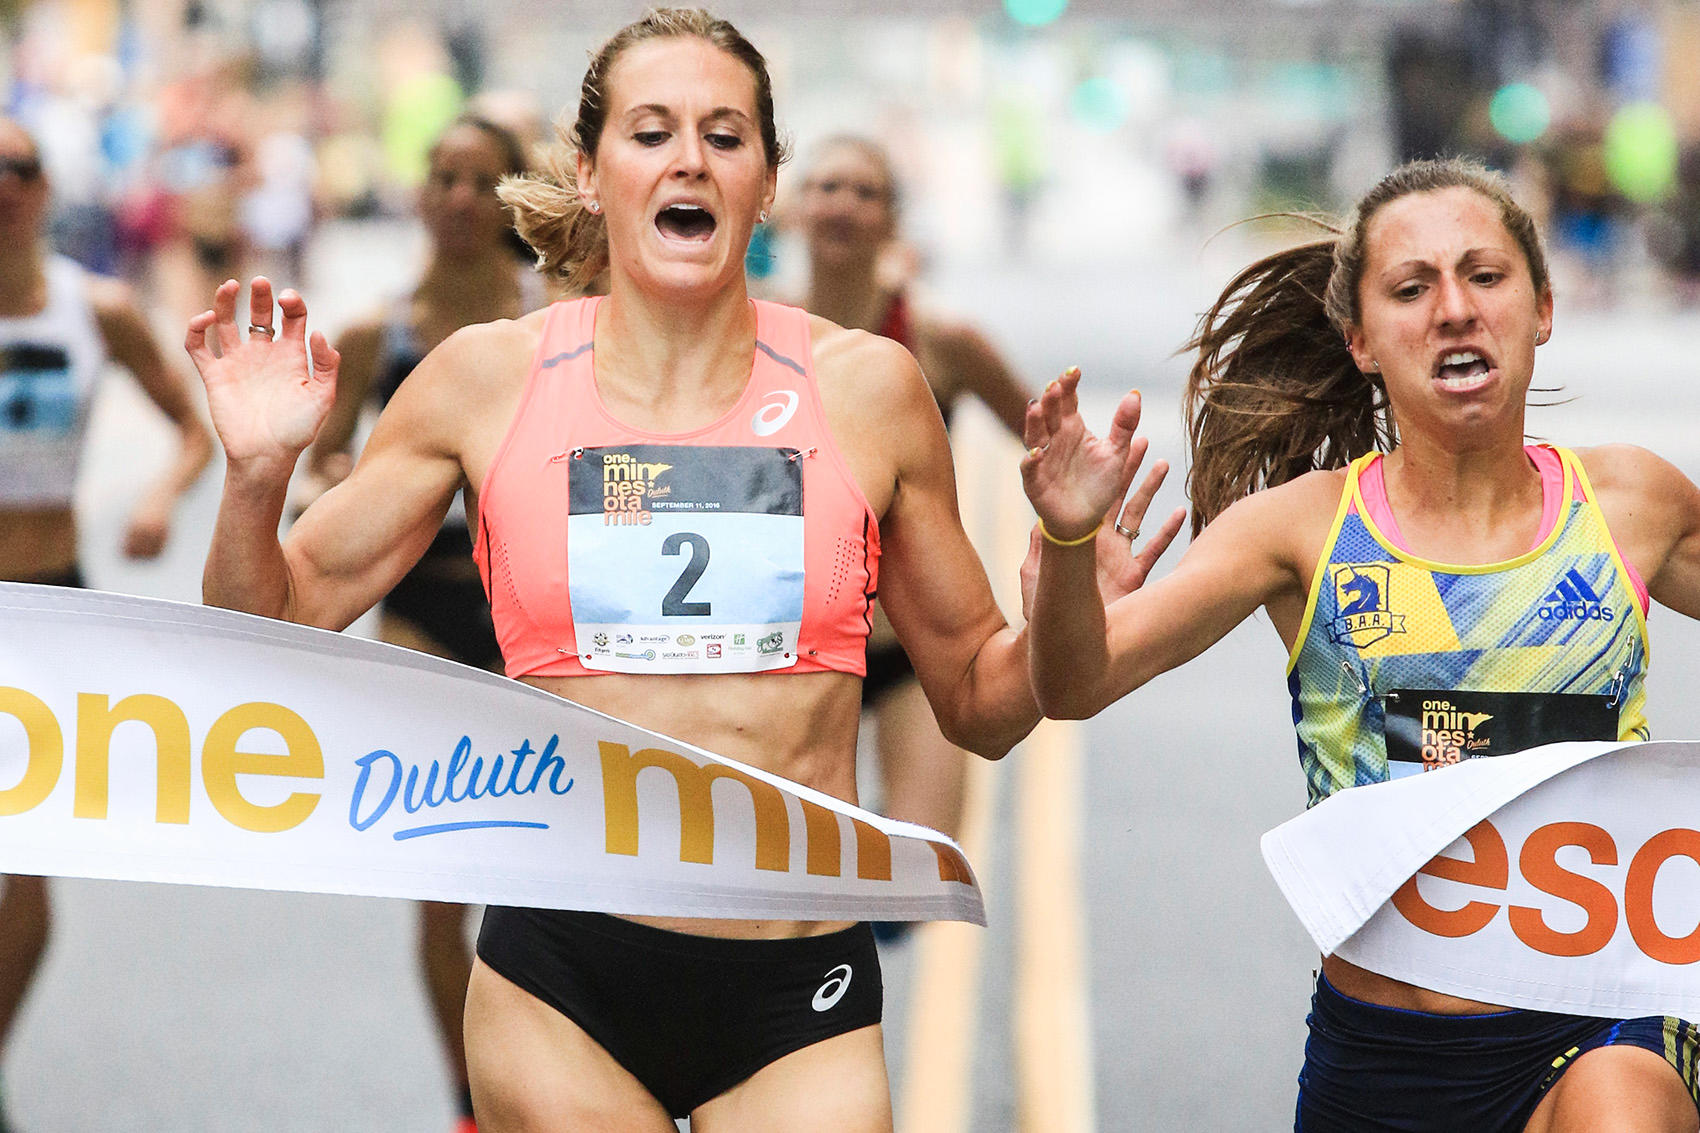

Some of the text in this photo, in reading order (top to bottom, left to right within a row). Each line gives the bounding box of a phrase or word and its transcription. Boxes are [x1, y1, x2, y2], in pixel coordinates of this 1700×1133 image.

[603, 453, 630, 464] one
[603, 457, 672, 481] min
[603, 480, 646, 497] nes
[603, 494, 642, 511] ota
[695, 502, 704, 510] 11,
[604, 509, 652, 526] mile
[661, 532, 711, 616] 2
[1538, 601, 1614, 622] adidas
[1345, 614, 1385, 631] B.A.A.
[1422, 700, 1451, 711] one
[1422, 705, 1494, 731] min
[1422, 729, 1466, 747] nes
[0, 686, 325, 833] one
[1421, 744, 1461, 763] ota
[349, 735, 574, 831] Duluth
